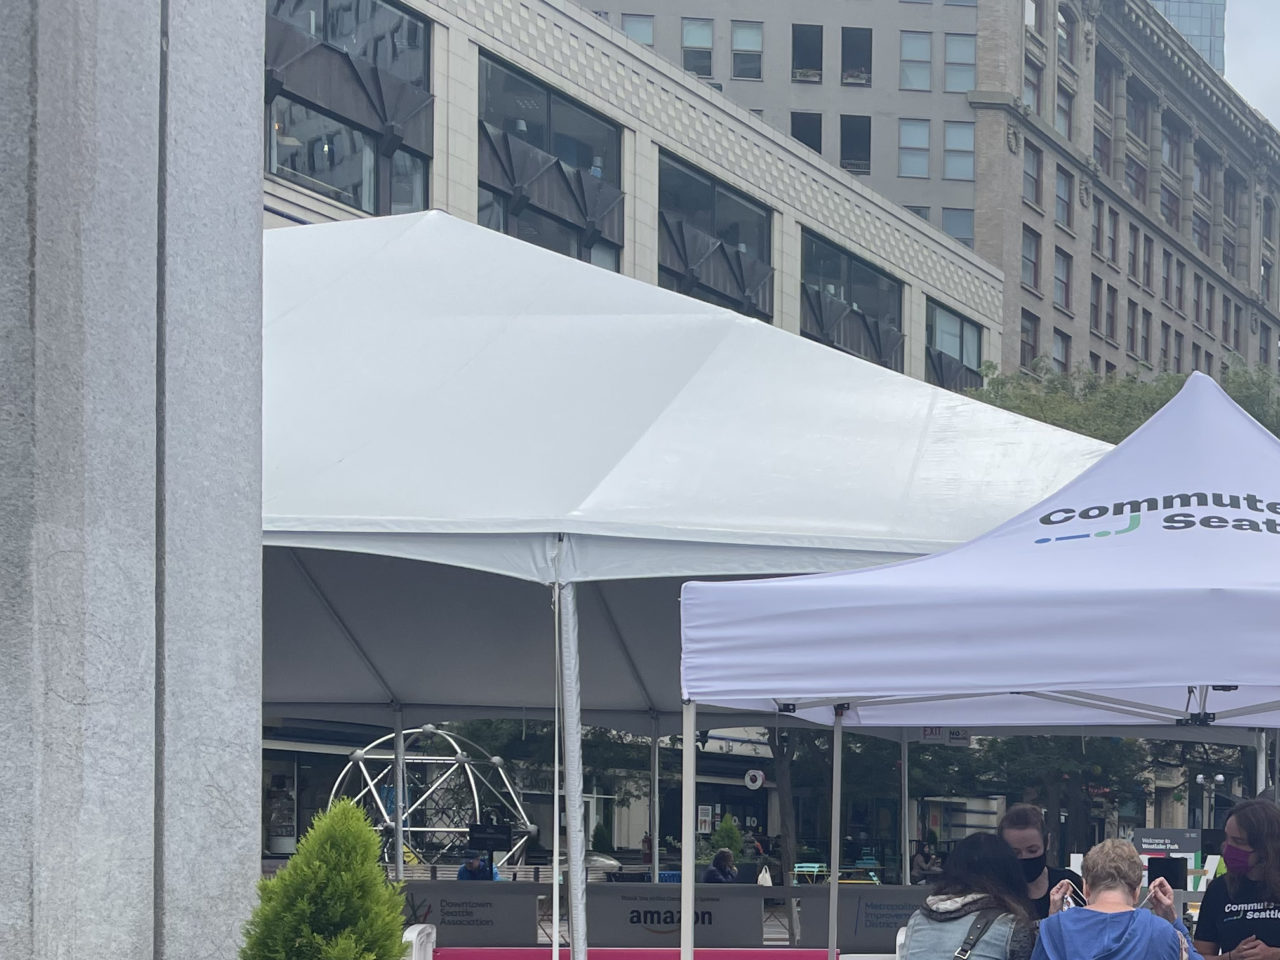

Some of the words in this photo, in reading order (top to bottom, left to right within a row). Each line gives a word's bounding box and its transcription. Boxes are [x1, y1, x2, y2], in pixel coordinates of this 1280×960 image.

[922, 726, 943, 737] EXIT
[439, 898, 493, 908] Downtown
[440, 908, 474, 917] Seattle
[439, 918, 494, 927] Association
